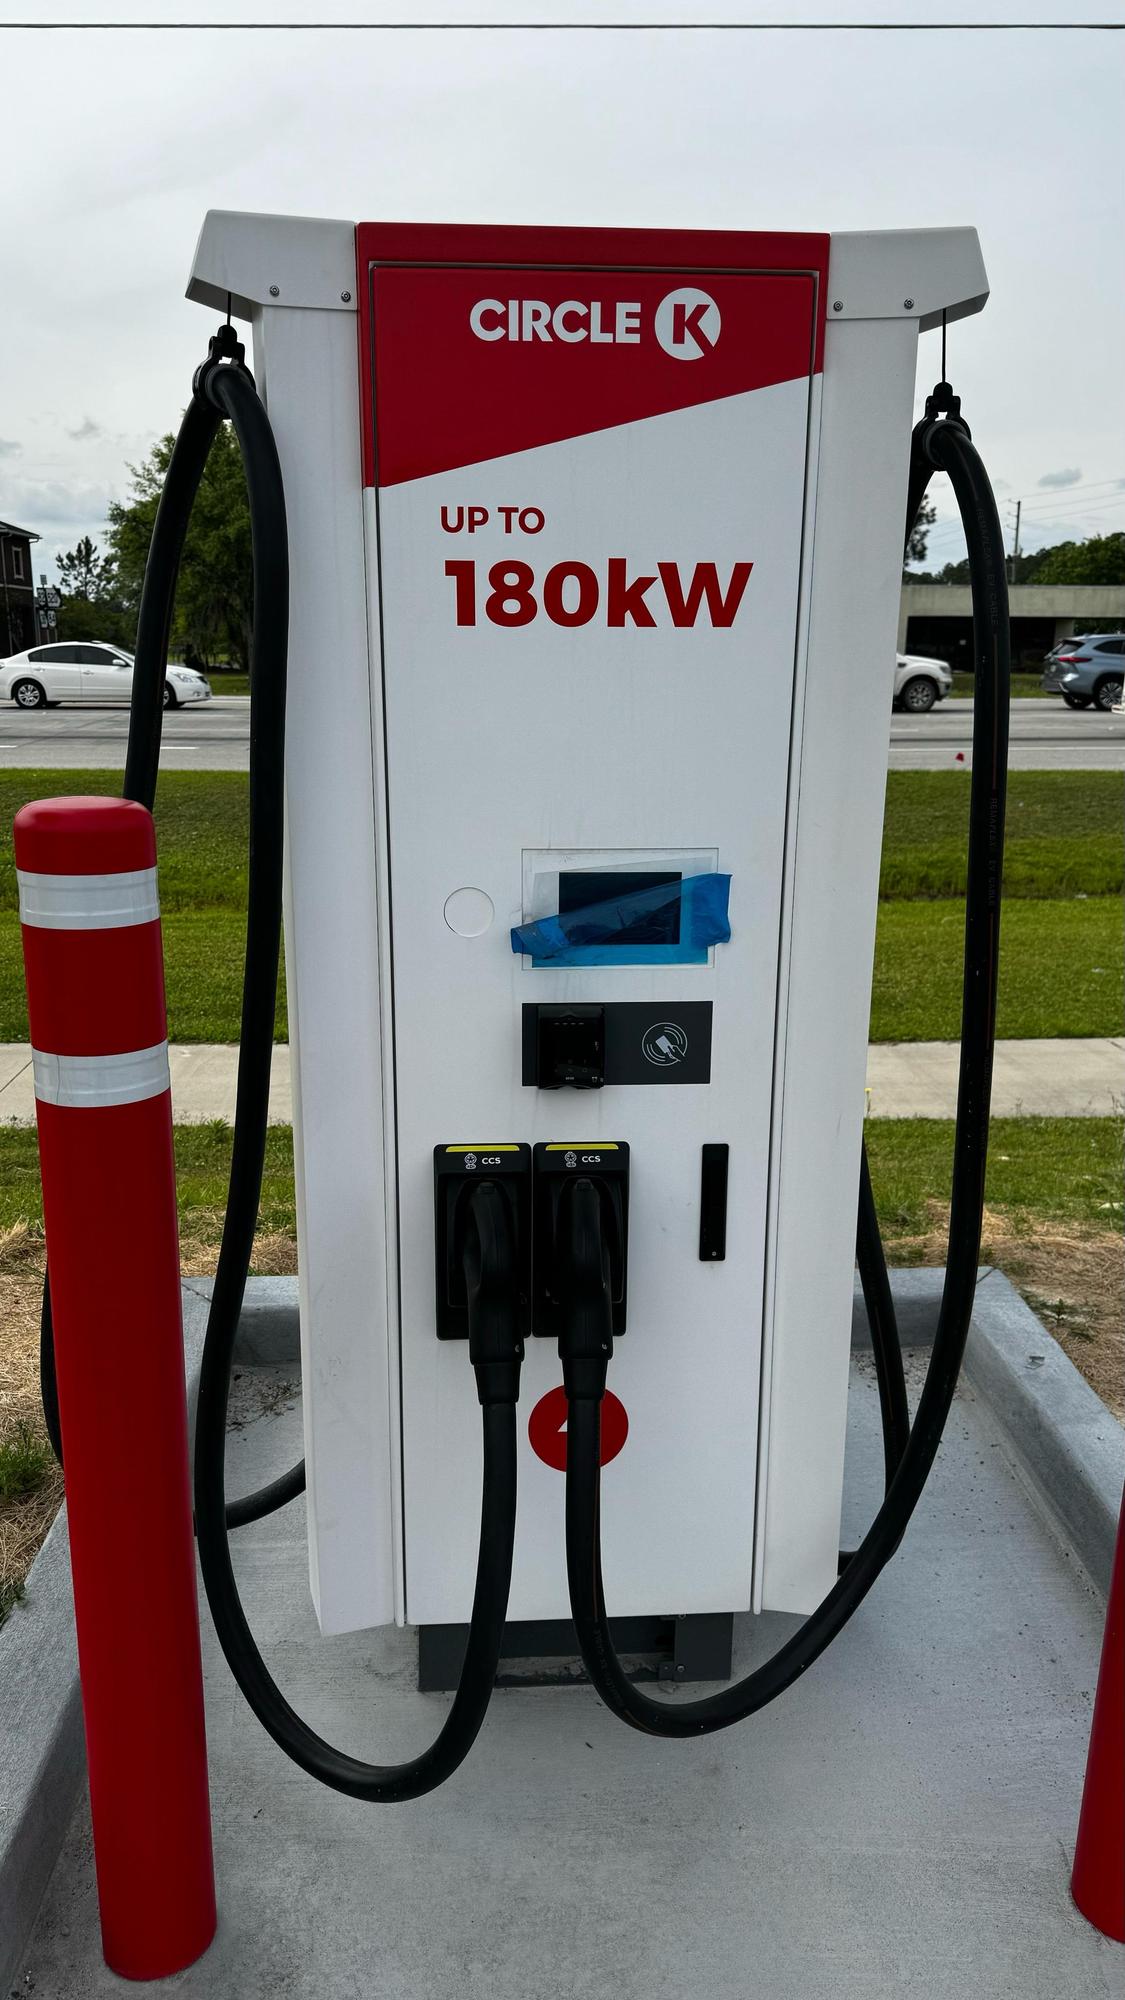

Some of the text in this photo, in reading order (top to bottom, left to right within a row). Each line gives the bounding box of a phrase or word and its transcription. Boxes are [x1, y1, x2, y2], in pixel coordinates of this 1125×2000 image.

[469, 298, 716, 358] CIRCLE K
[440, 505, 545, 534] UP TO
[444, 557, 754, 628] 180kW
[481, 1156, 501, 1165] CCS
[581, 1154, 601, 1163] CCS
